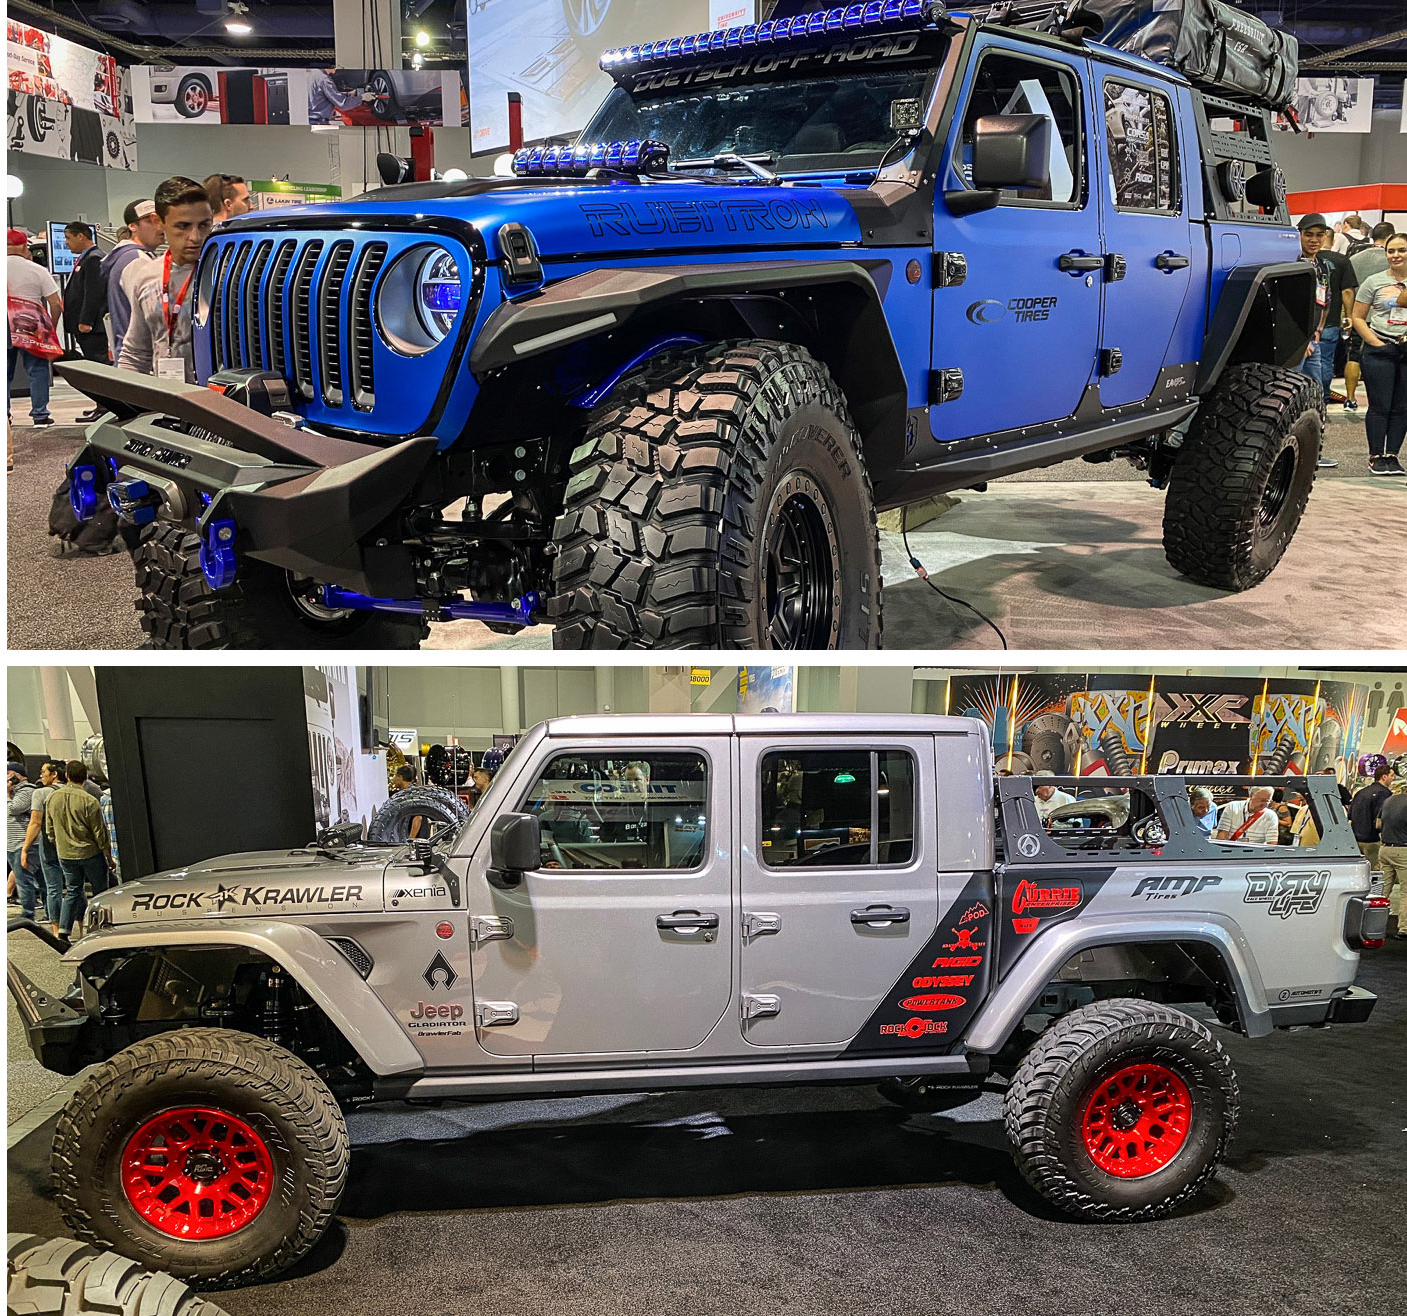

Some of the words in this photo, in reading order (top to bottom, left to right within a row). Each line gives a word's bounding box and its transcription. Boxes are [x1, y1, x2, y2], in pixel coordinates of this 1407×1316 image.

[1007, 297, 1058, 310] COOPER
[1015, 309, 1050, 323] TIRES
[22, 337, 58, 350] SPYDER
[1157, 750, 1241, 775] Primax
[1131, 876, 1223, 897] AMP
[131, 892, 205, 911] ROCK
[242, 885, 363, 905] KRAWLER
[1012, 879, 1080, 914] CURRIE
[1146, 892, 1177, 901] Tires
[932, 956, 982, 968] RIGID
[912, 975, 974, 988] ODYSSEY
[410, 1001, 464, 1020] Jeep
[880, 1024, 907, 1034] ROCK
[924, 1021, 948, 1033] JOCK
